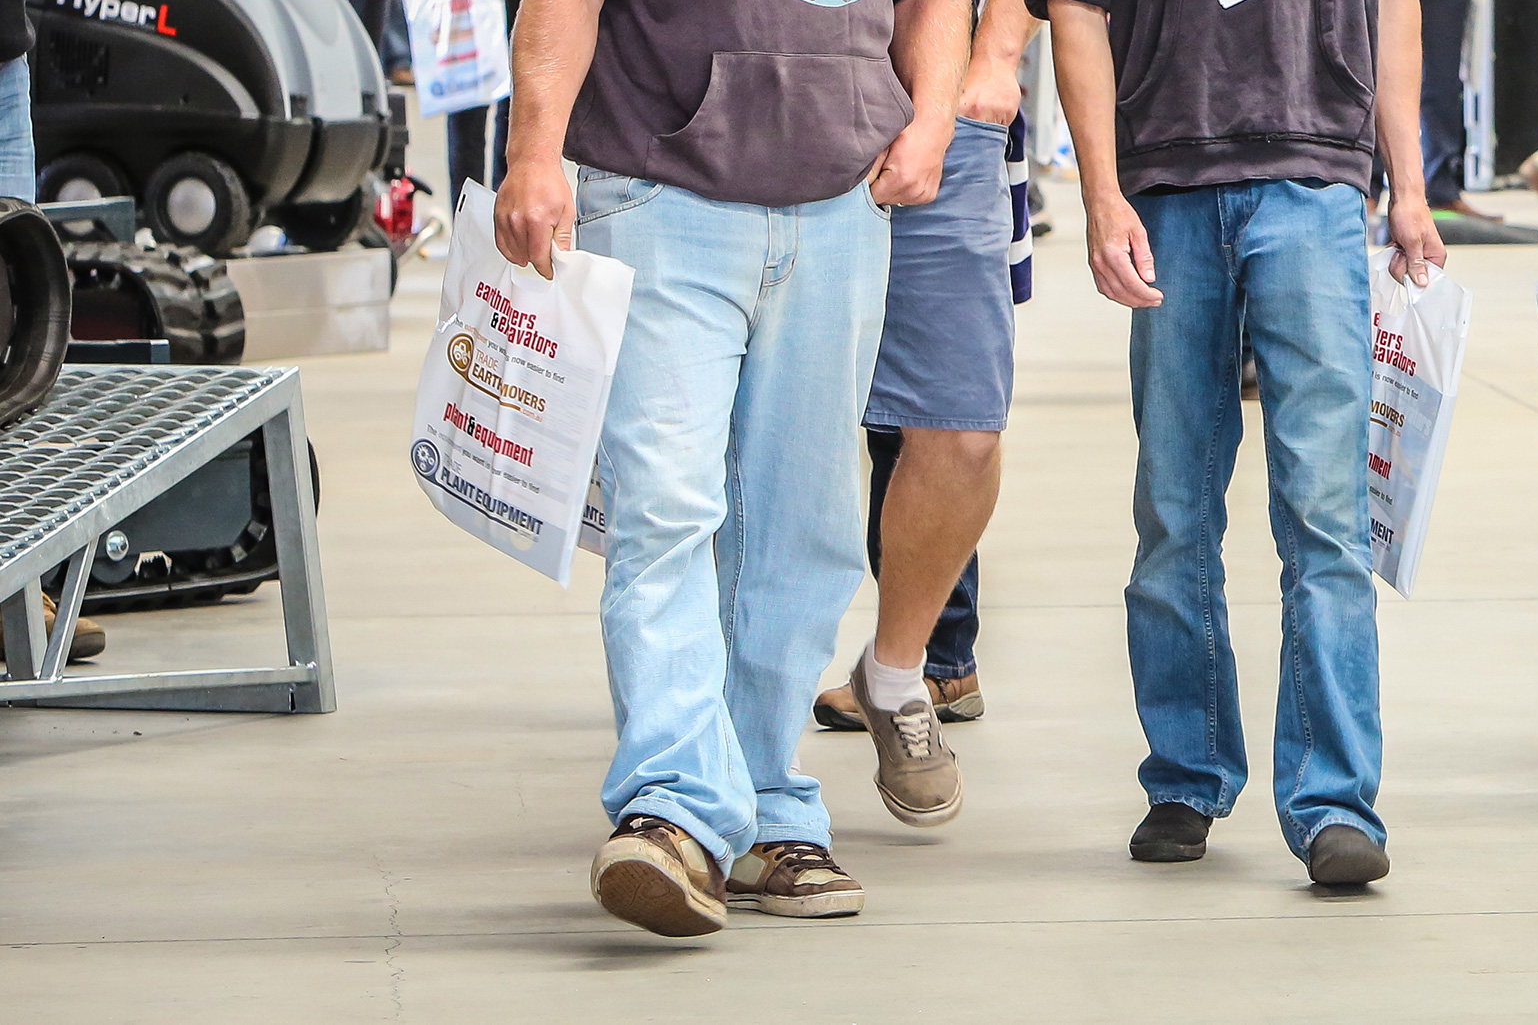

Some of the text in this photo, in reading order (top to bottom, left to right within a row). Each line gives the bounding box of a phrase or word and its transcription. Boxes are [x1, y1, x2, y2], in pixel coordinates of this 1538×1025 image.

[475, 349, 499, 372] TRADE
[1373, 342, 1417, 377] cavators
[552, 372, 565, 384] find
[1382, 375, 1394, 386] now
[443, 402, 535, 467] plant&equpment
